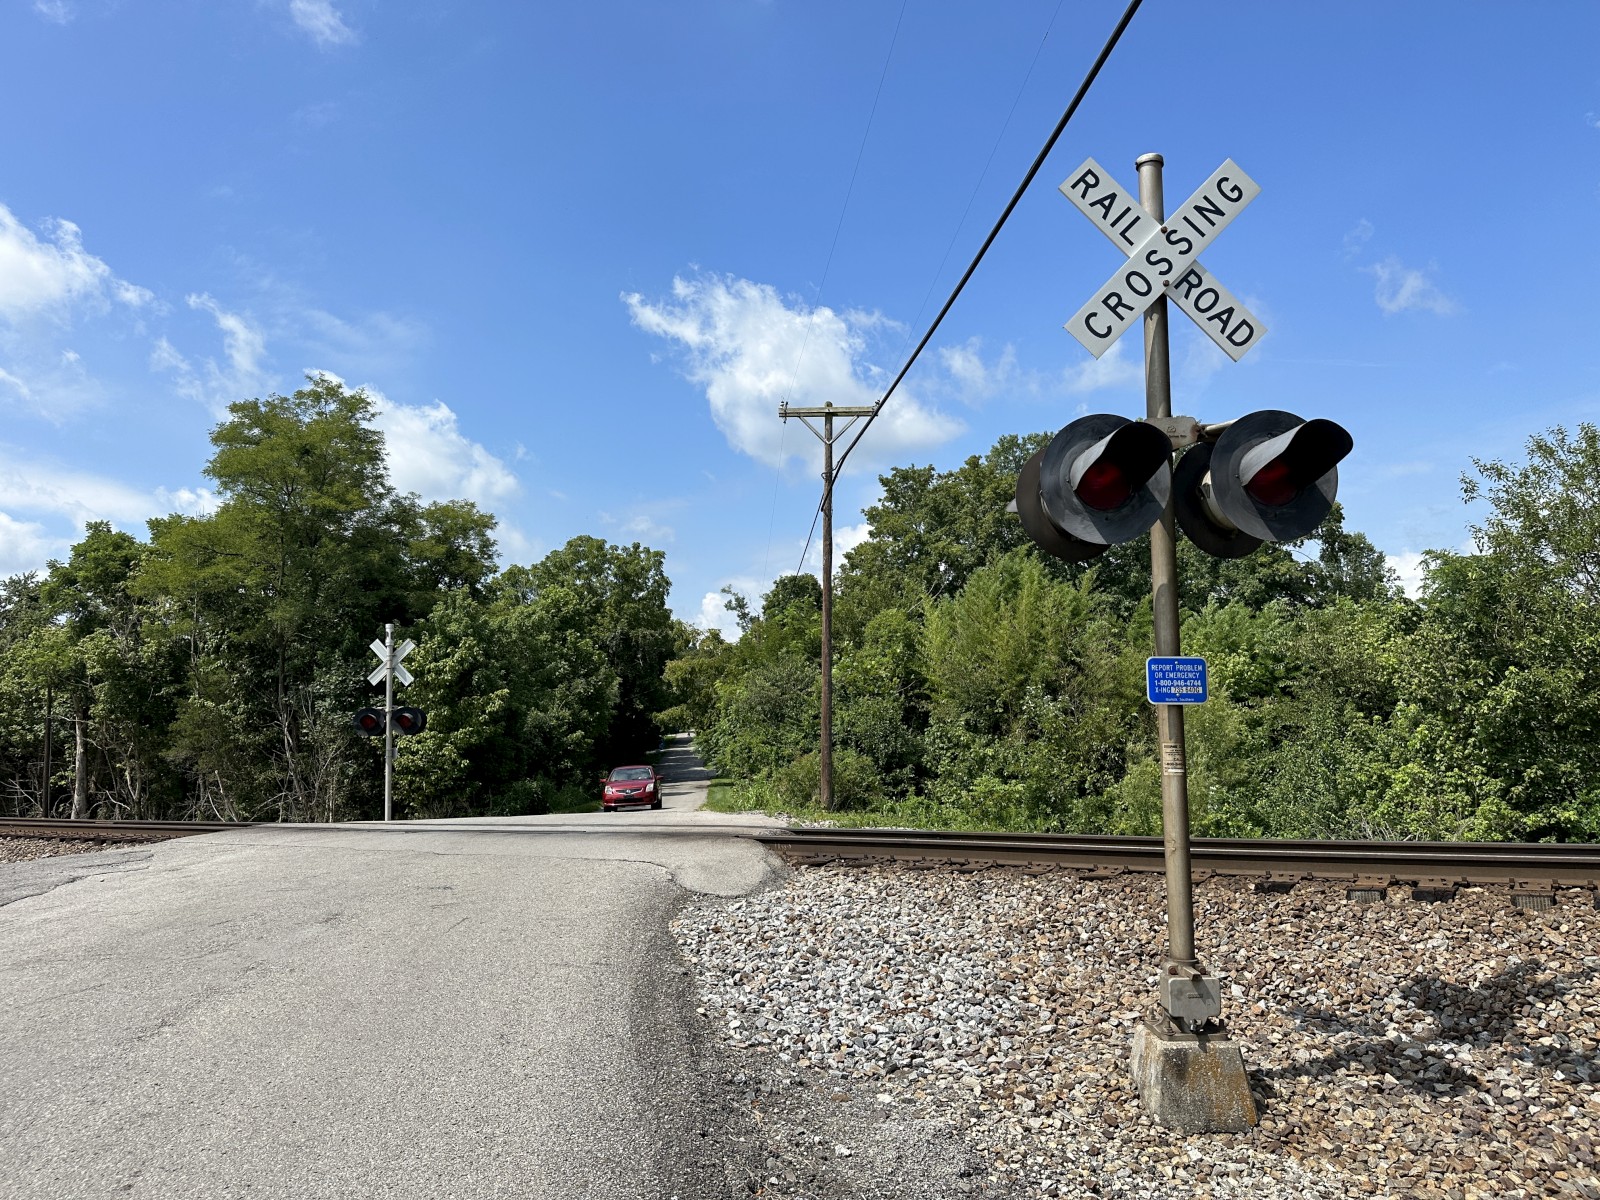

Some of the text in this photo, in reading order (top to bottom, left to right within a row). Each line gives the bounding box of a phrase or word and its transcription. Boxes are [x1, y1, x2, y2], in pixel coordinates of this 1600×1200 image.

[1070, 168, 1254, 347] RAIL ROAD
[1084, 176, 1244, 339] CROSSING
